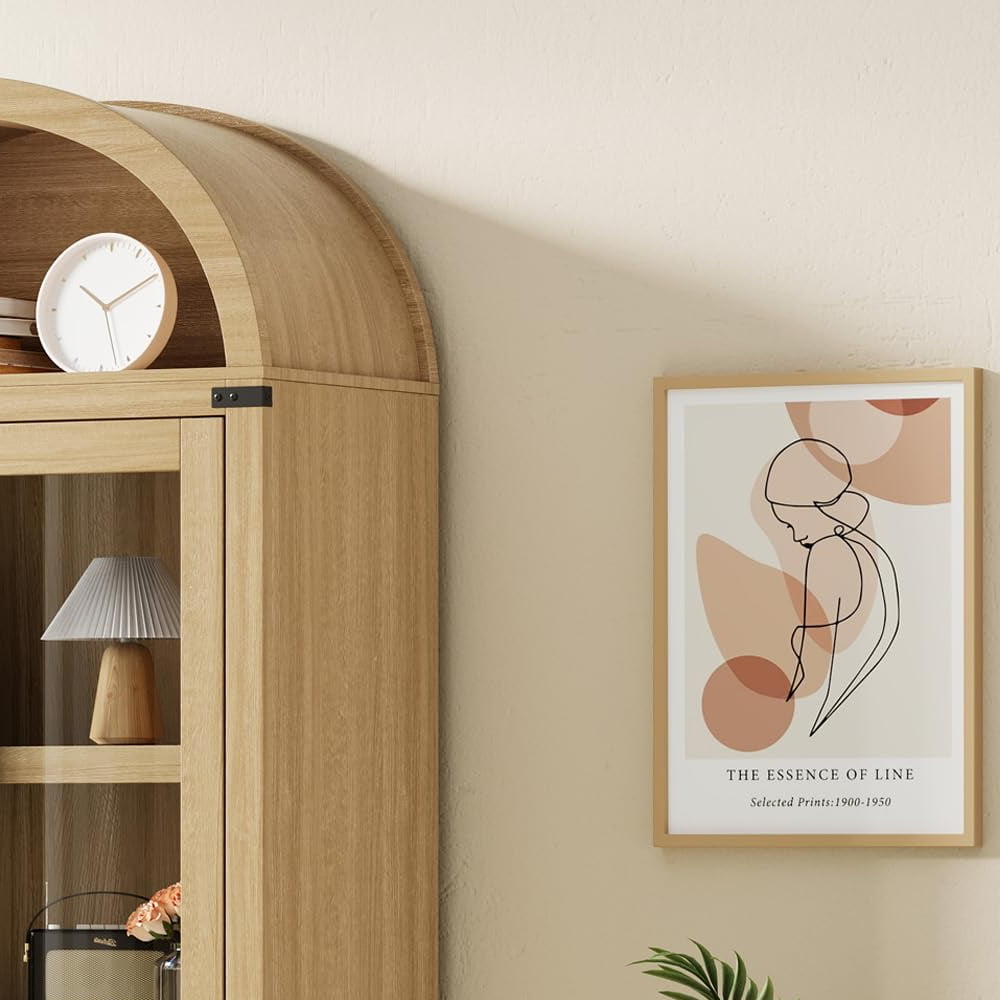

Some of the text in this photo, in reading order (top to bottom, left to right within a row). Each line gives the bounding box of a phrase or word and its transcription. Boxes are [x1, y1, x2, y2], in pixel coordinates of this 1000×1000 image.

[726, 768, 915, 781] THE ESSENCE OF LINE
[750, 796, 892, 808] Selected Prints:1900-1950
